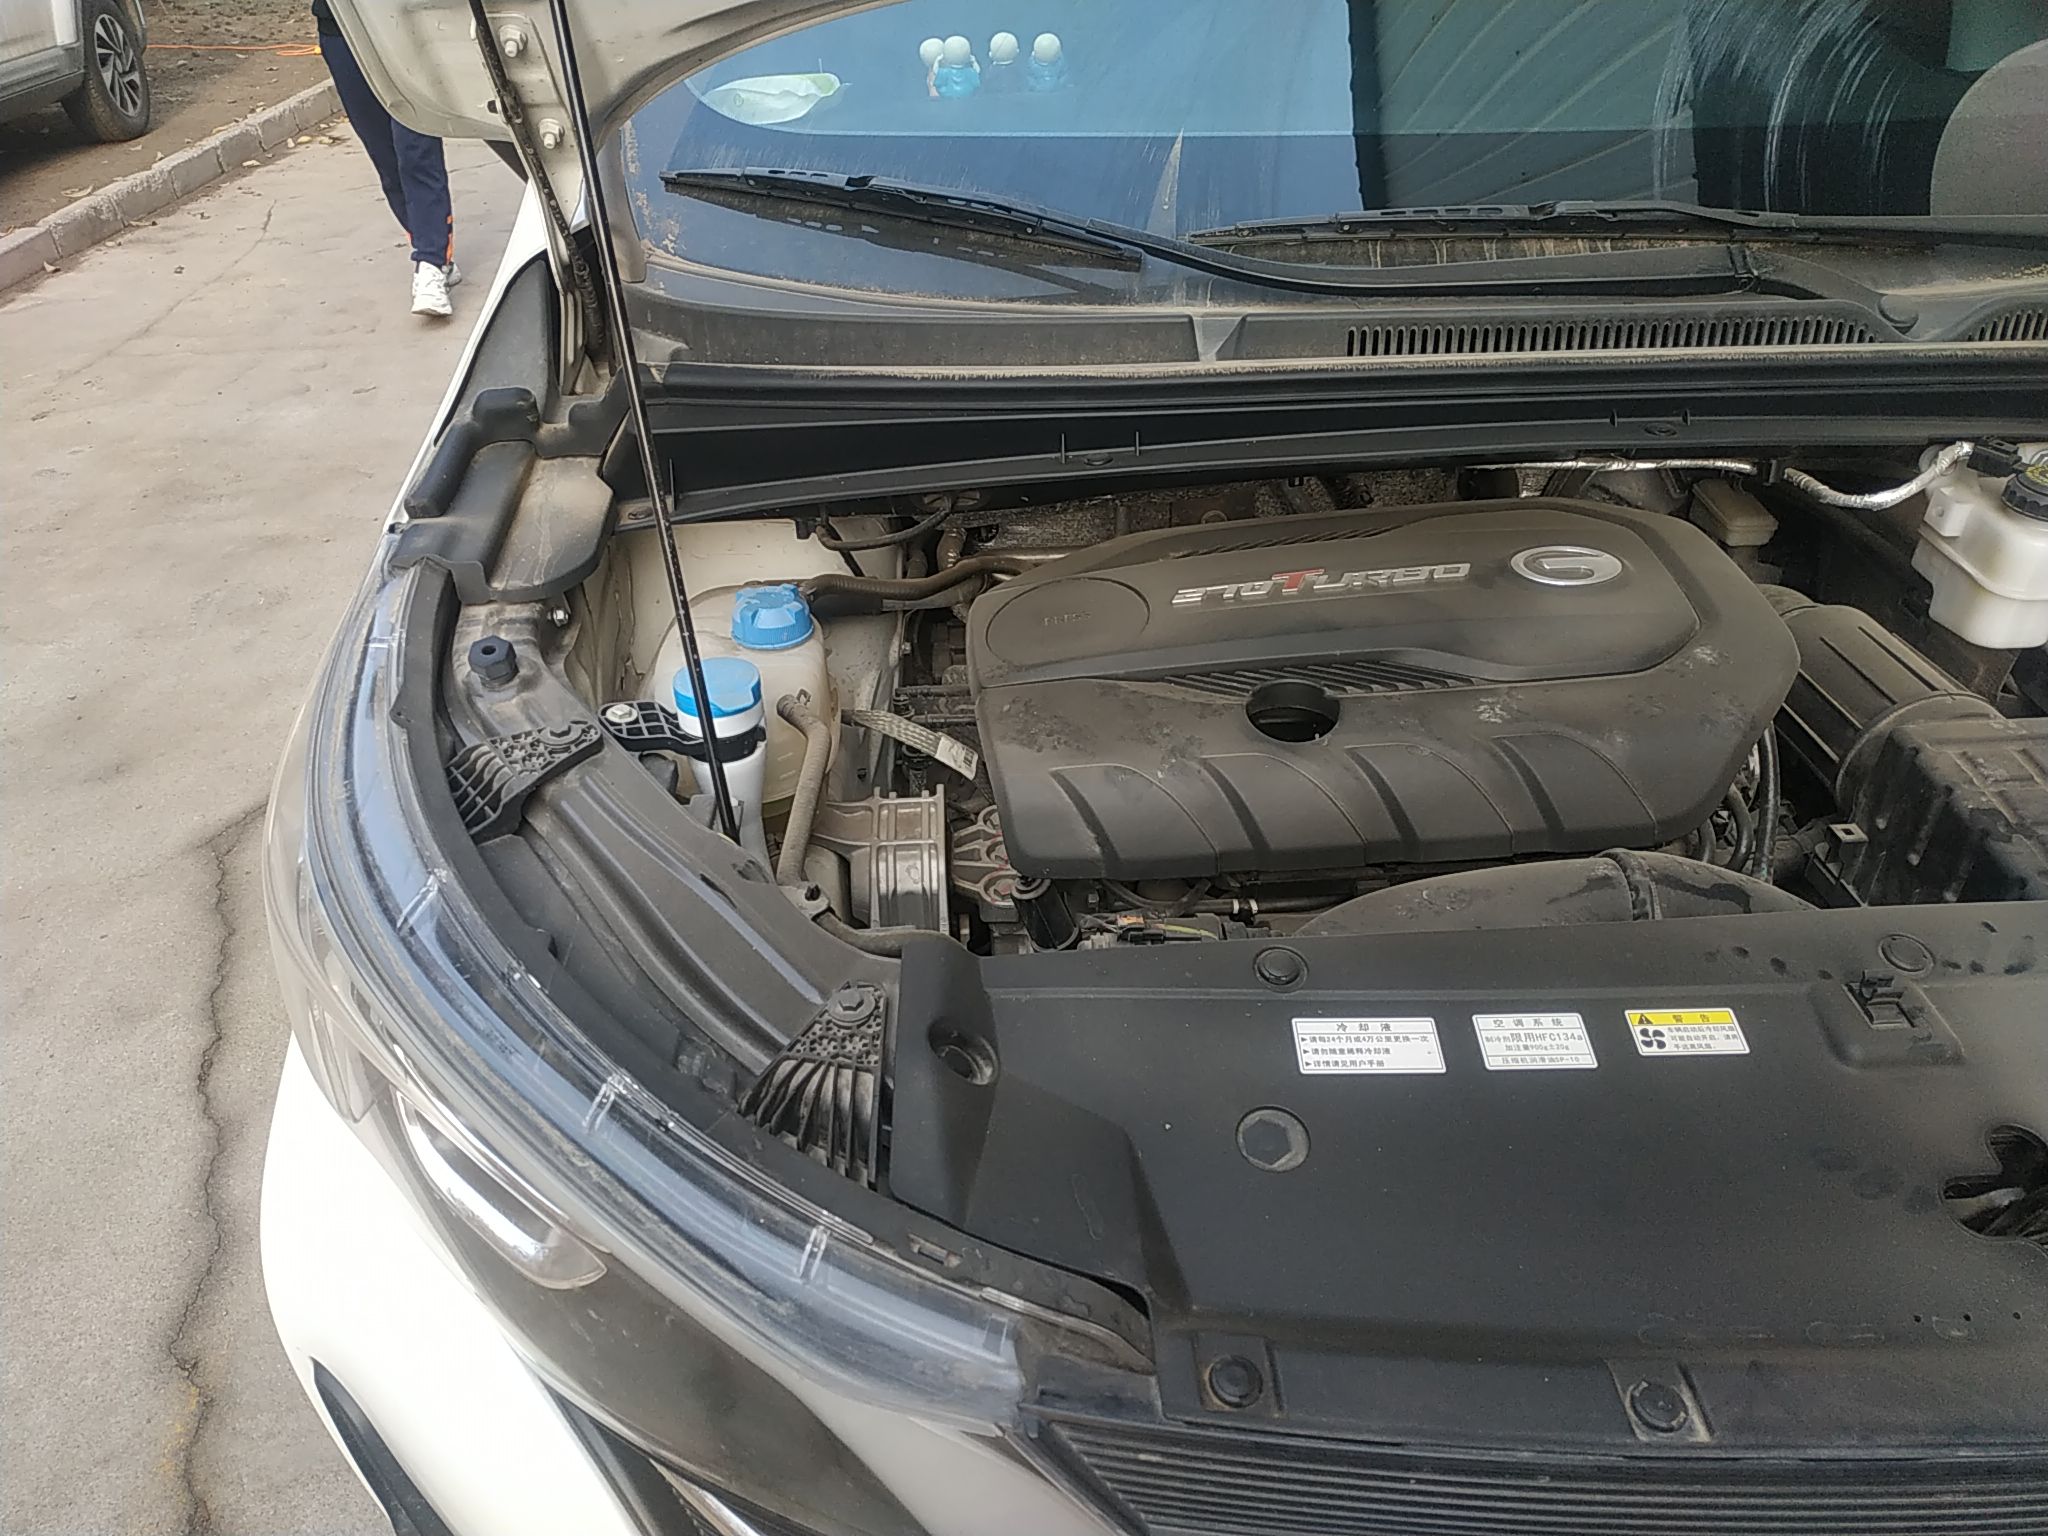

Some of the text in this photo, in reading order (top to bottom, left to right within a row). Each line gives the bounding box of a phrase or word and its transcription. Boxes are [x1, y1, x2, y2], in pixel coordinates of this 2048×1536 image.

[1493, 1018, 1564, 1028] 空调系统
[1672, 1014, 1710, 1023] 警告
[1336, 1023, 1392, 1032] 冷却液
